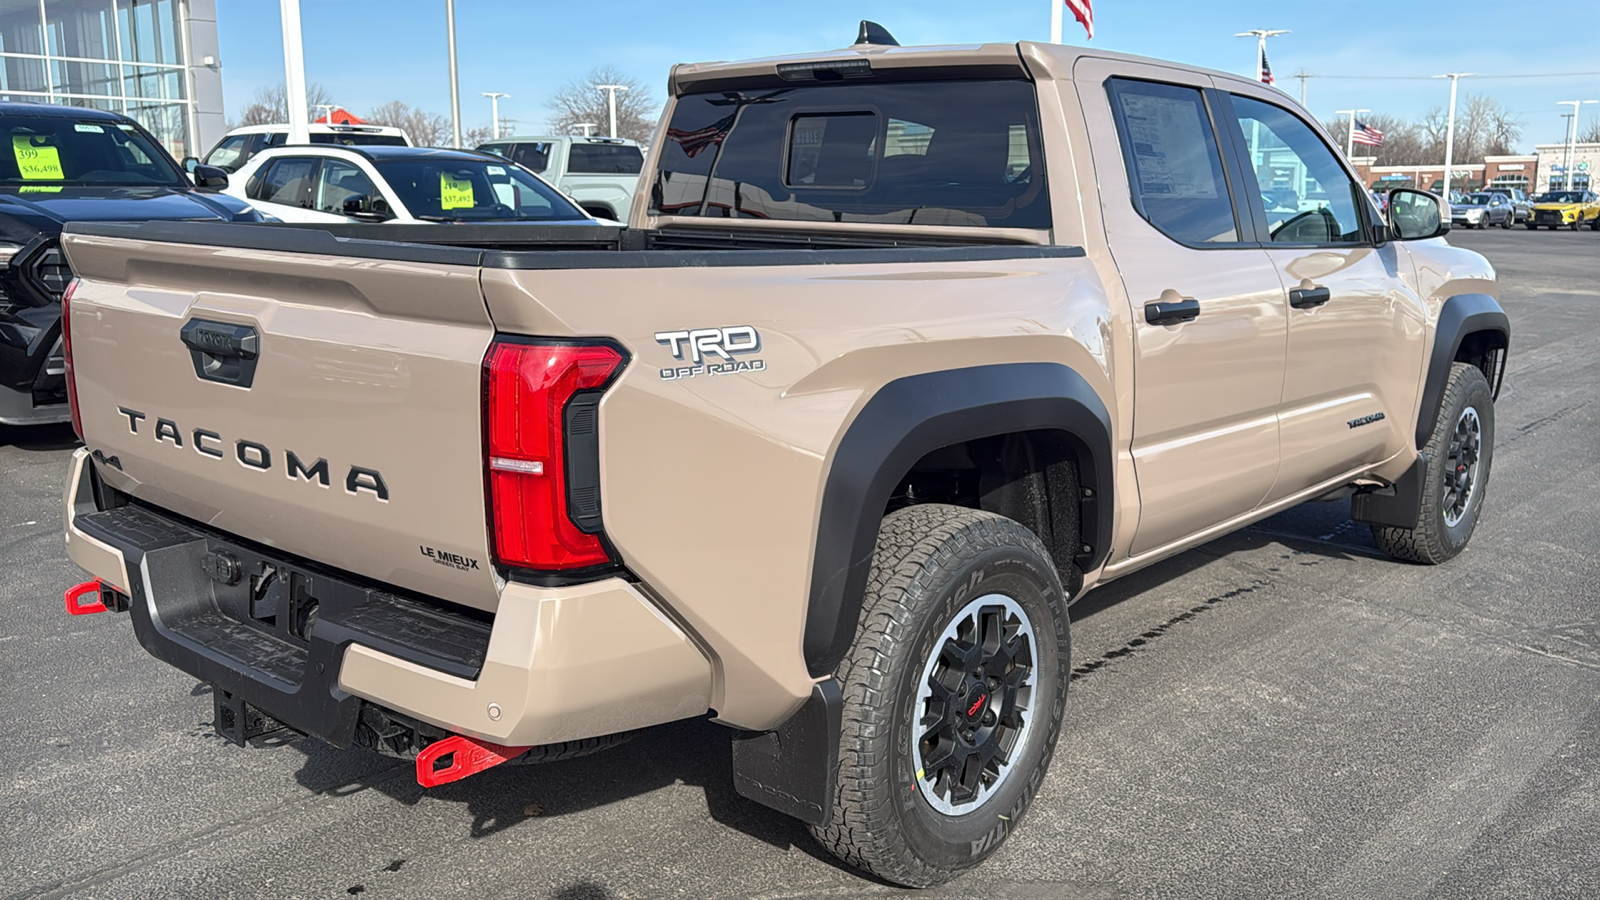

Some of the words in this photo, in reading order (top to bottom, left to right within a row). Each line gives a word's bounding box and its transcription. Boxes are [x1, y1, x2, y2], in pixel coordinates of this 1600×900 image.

[18, 150, 38, 160] 399
[22, 164, 59, 174] $36,498
[198, 329, 234, 350] TOYOTA
[654, 325, 762, 366] TRD
[660, 365, 704, 380] OFF
[707, 359, 767, 377] ROAD
[117, 405, 389, 503] TACOMA
[419, 545, 436, 558] LE
[437, 549, 480, 570] MIEUX
[432, 558, 455, 568] GREEN
[455, 564, 470, 572] BAY
